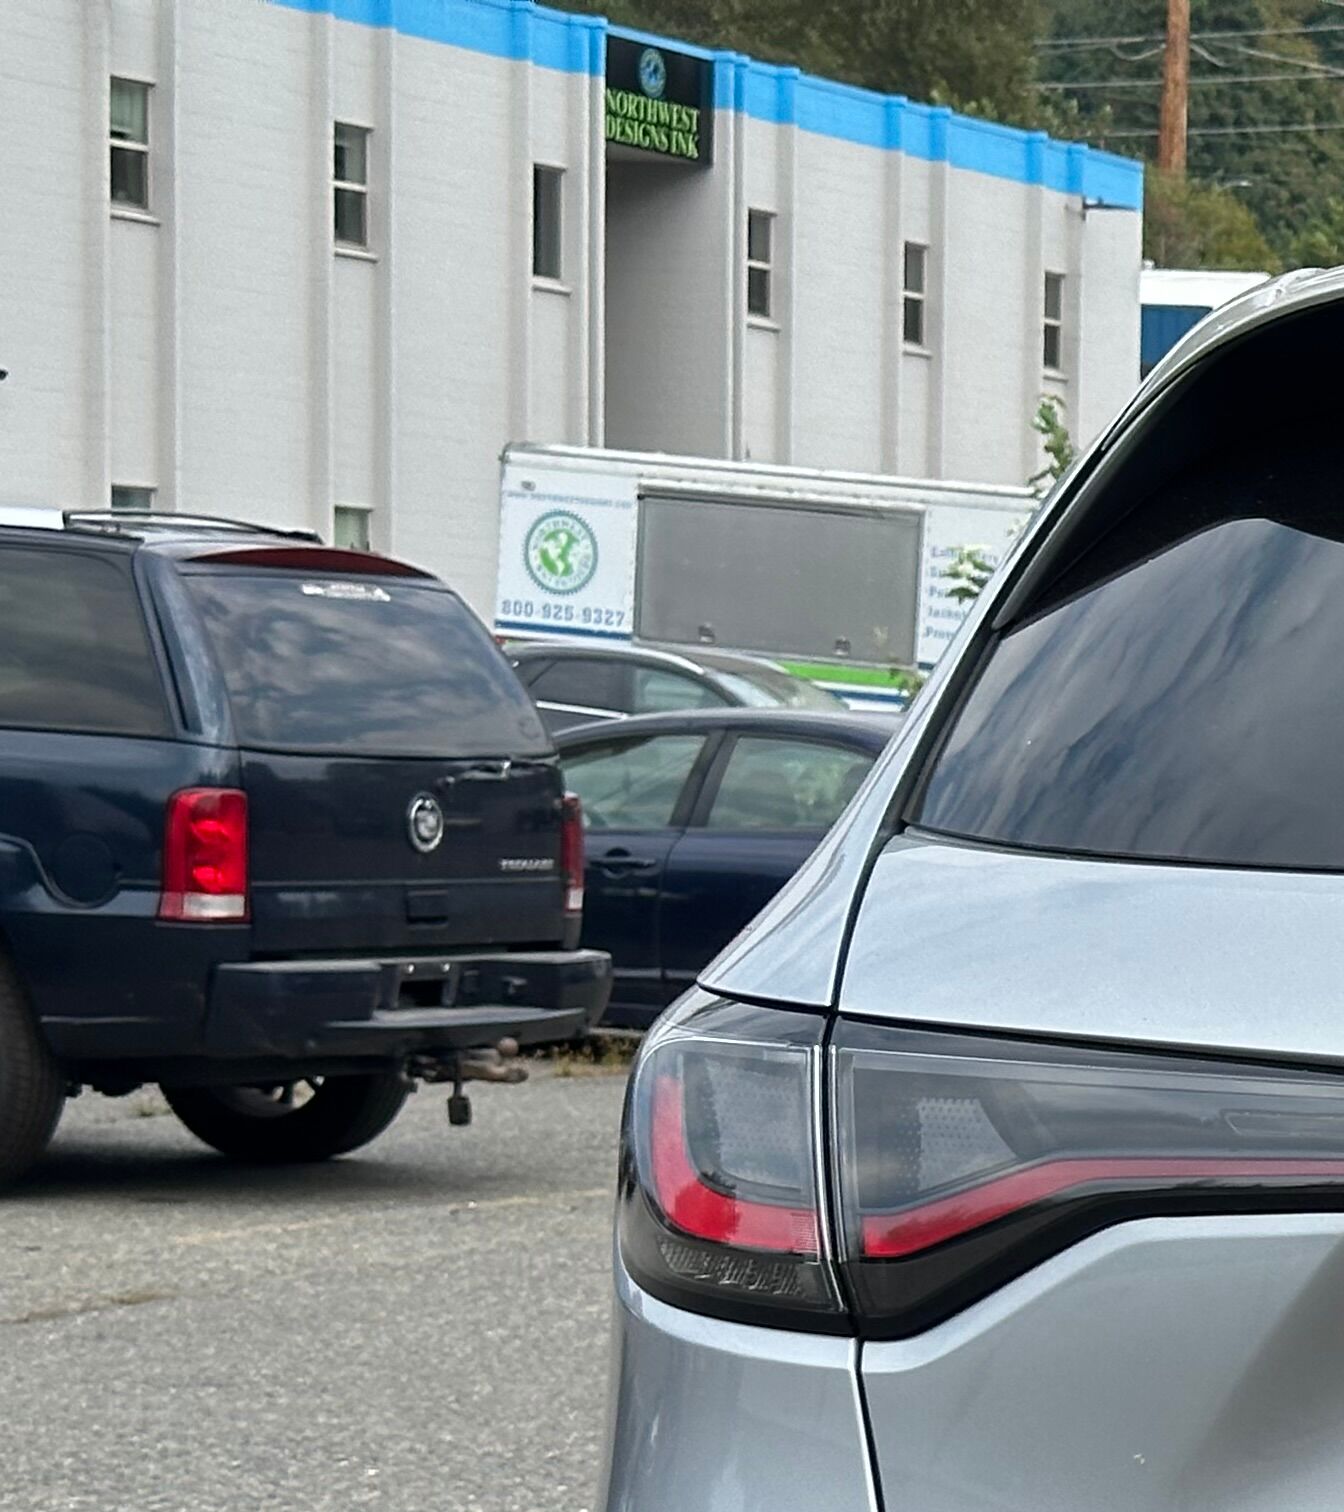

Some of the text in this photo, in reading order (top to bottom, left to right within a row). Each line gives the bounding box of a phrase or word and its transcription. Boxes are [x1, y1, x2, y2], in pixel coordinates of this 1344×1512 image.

[606, 87, 700, 133] NORTHWEST
[606, 114, 699, 159] DESIGNS INK
